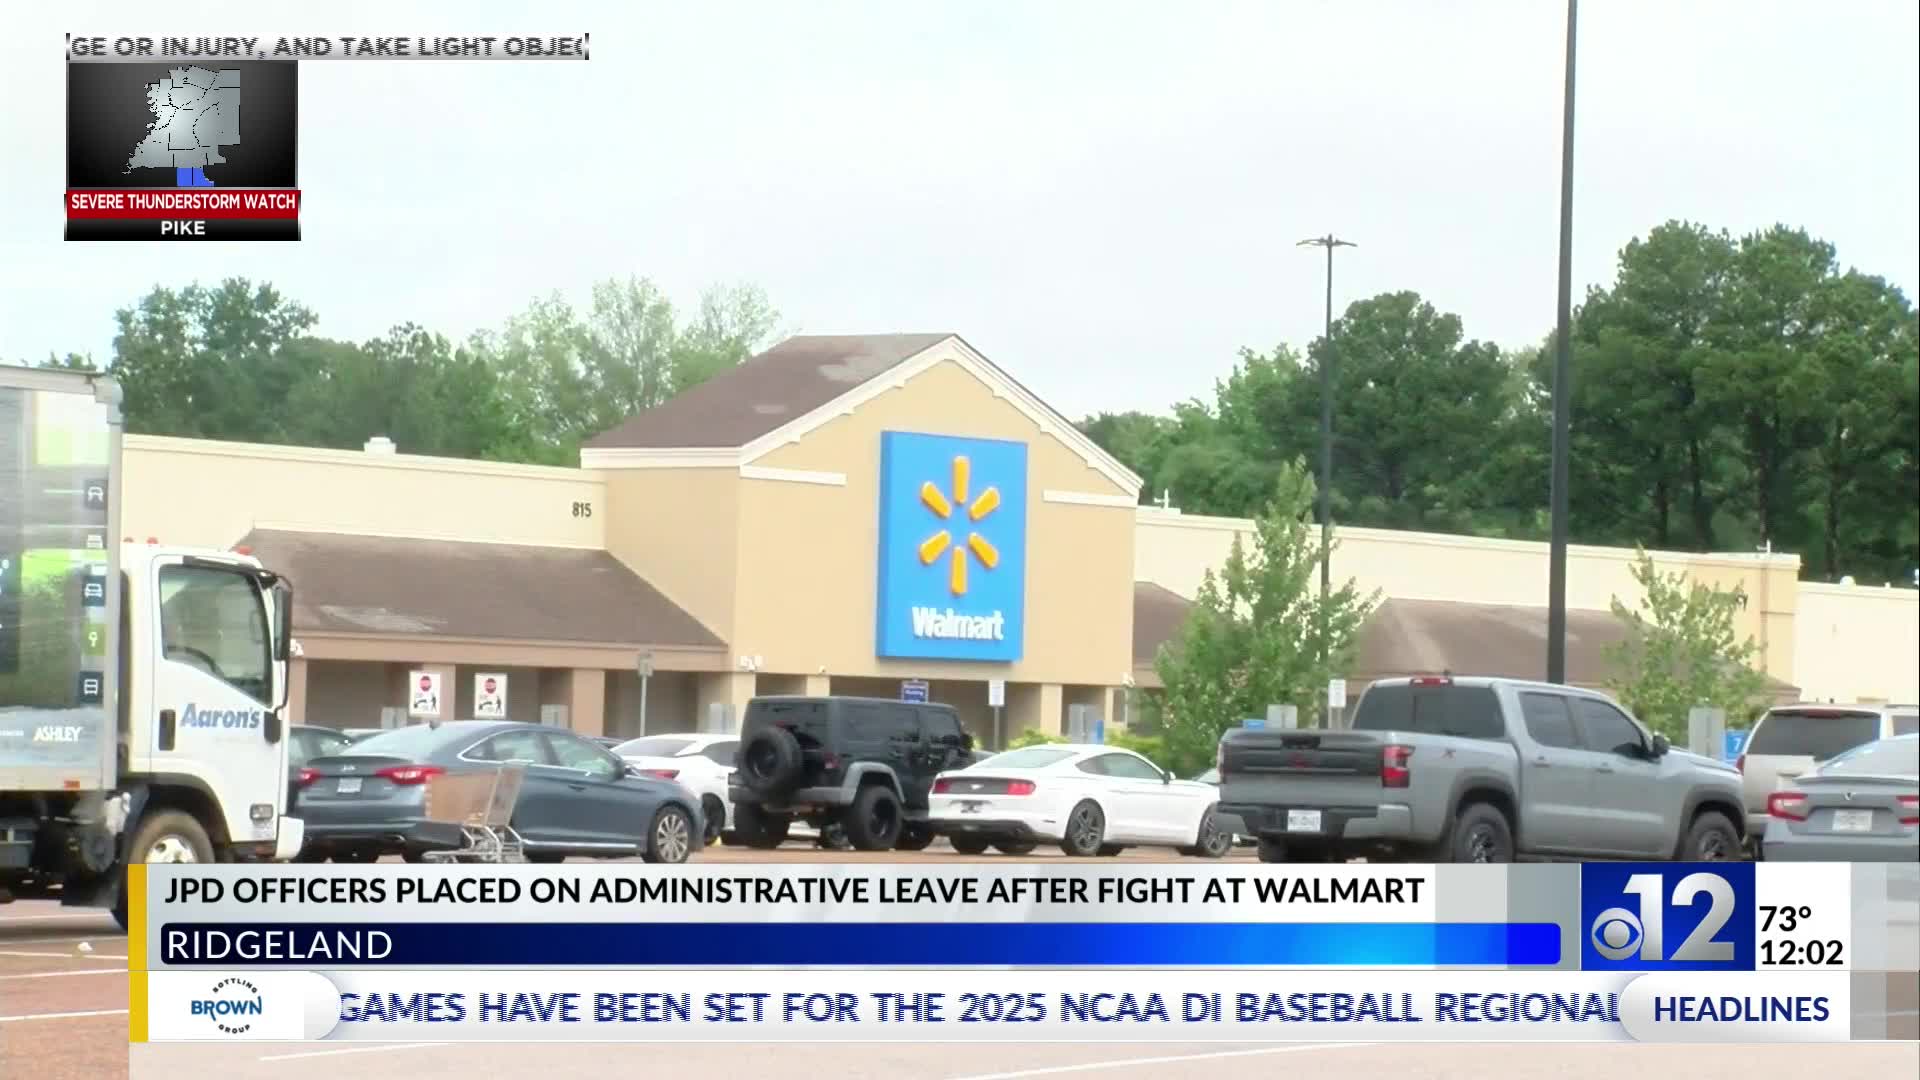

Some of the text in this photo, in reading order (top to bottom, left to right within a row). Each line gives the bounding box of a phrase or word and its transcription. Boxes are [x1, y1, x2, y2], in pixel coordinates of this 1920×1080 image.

[572, 501, 592, 518] 815
[911, 606, 1004, 641] Walmart
[180, 703, 261, 729] Aaron's
[33, 725, 83, 743] ASHLEY
